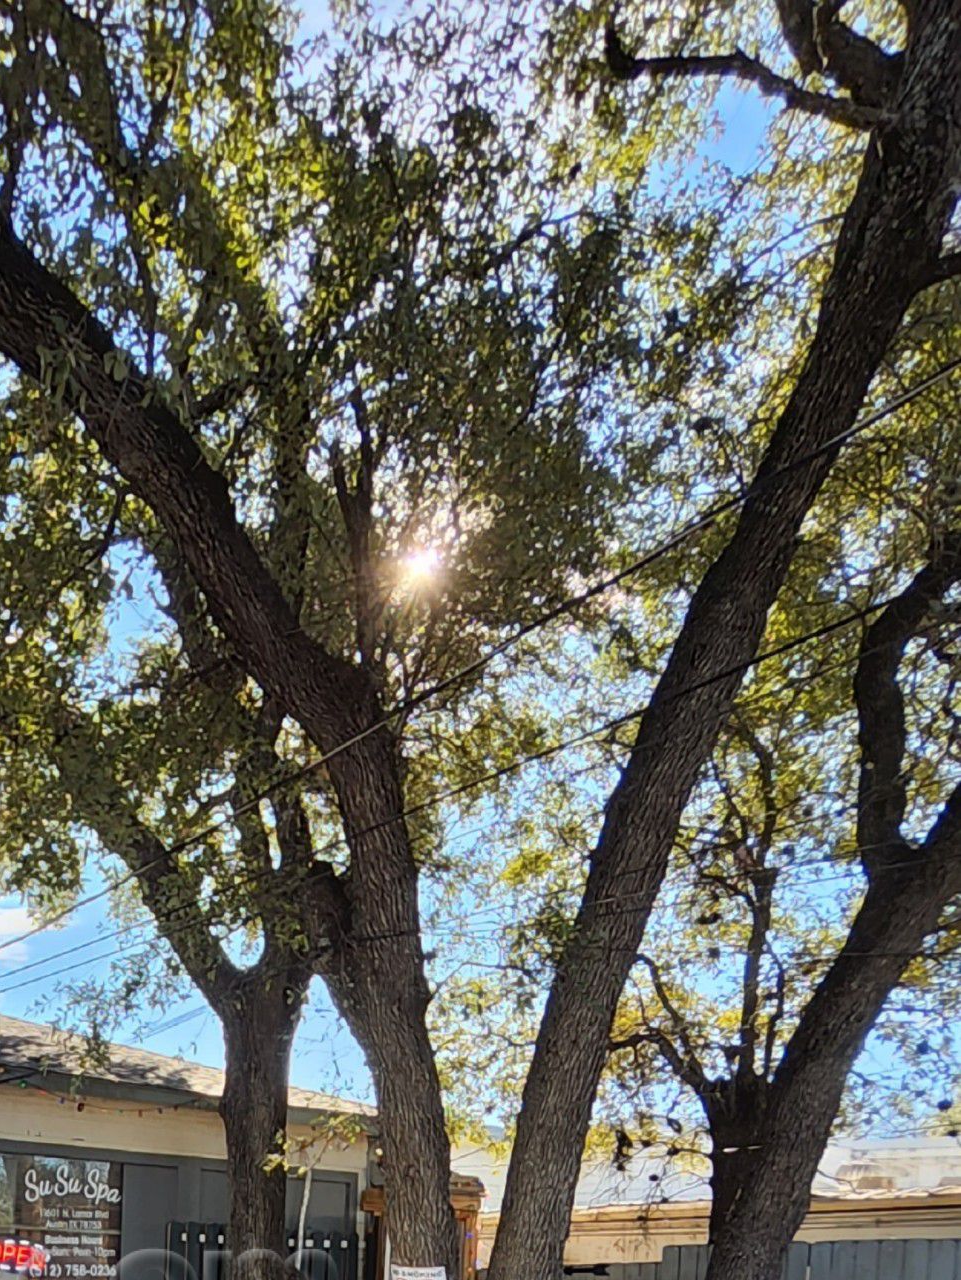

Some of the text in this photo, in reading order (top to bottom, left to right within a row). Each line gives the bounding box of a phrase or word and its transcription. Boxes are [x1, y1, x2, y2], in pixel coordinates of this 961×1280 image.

[84, 1168, 122, 1205] Spa
[44, 1234, 79, 1245] Business
[64, 1263, 117, 1277] 758-0236
